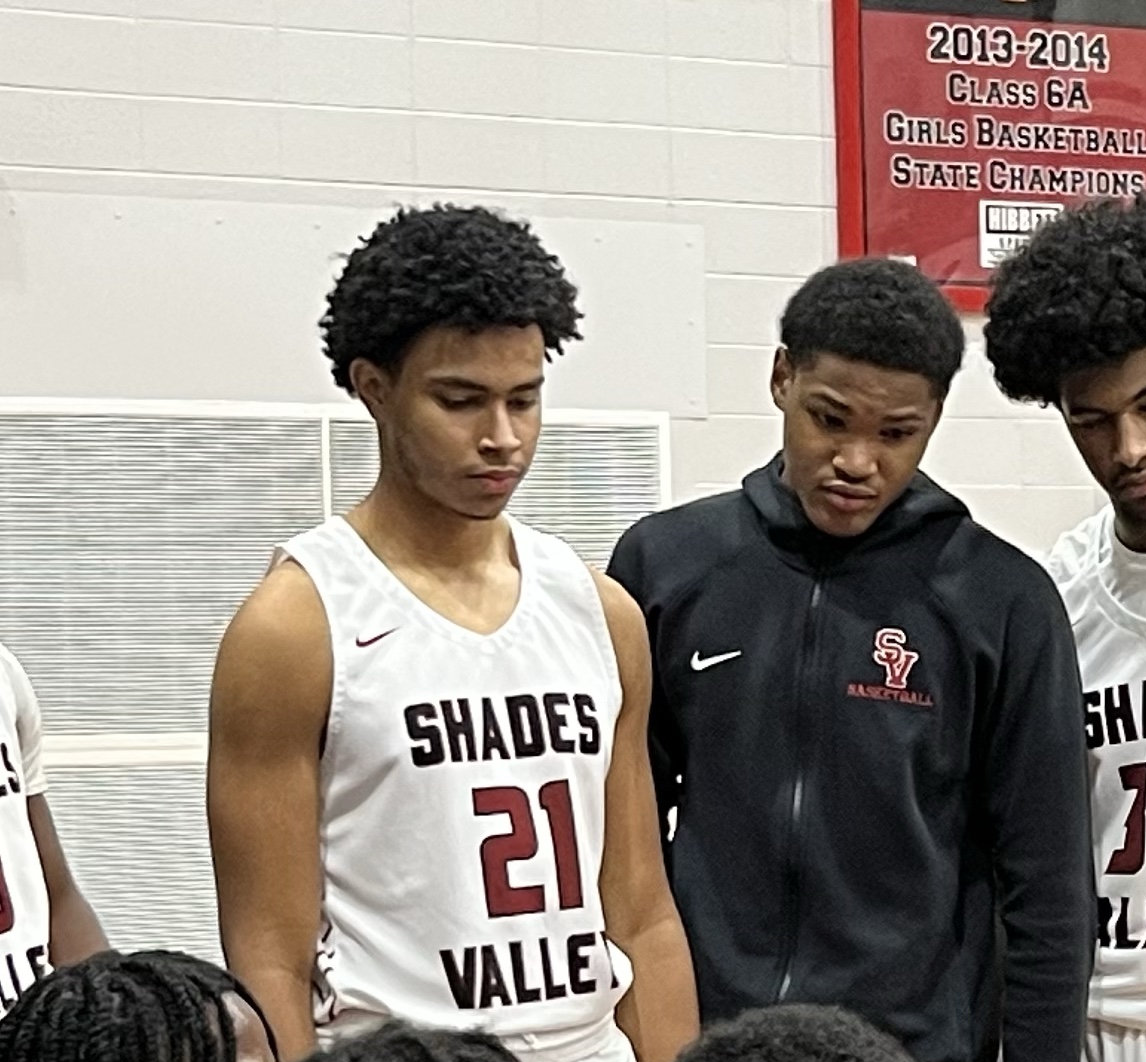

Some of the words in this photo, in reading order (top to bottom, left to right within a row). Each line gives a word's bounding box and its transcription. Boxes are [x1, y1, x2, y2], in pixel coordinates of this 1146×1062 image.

[928, 23, 1109, 72] 2013-2014
[1046, 79, 1091, 111] 6A
[847, 683, 934, 706] BASKETBALL
[404, 692, 600, 768] SHADES
[472, 779, 584, 918] 21
[439, 931, 619, 1010] VALLE
